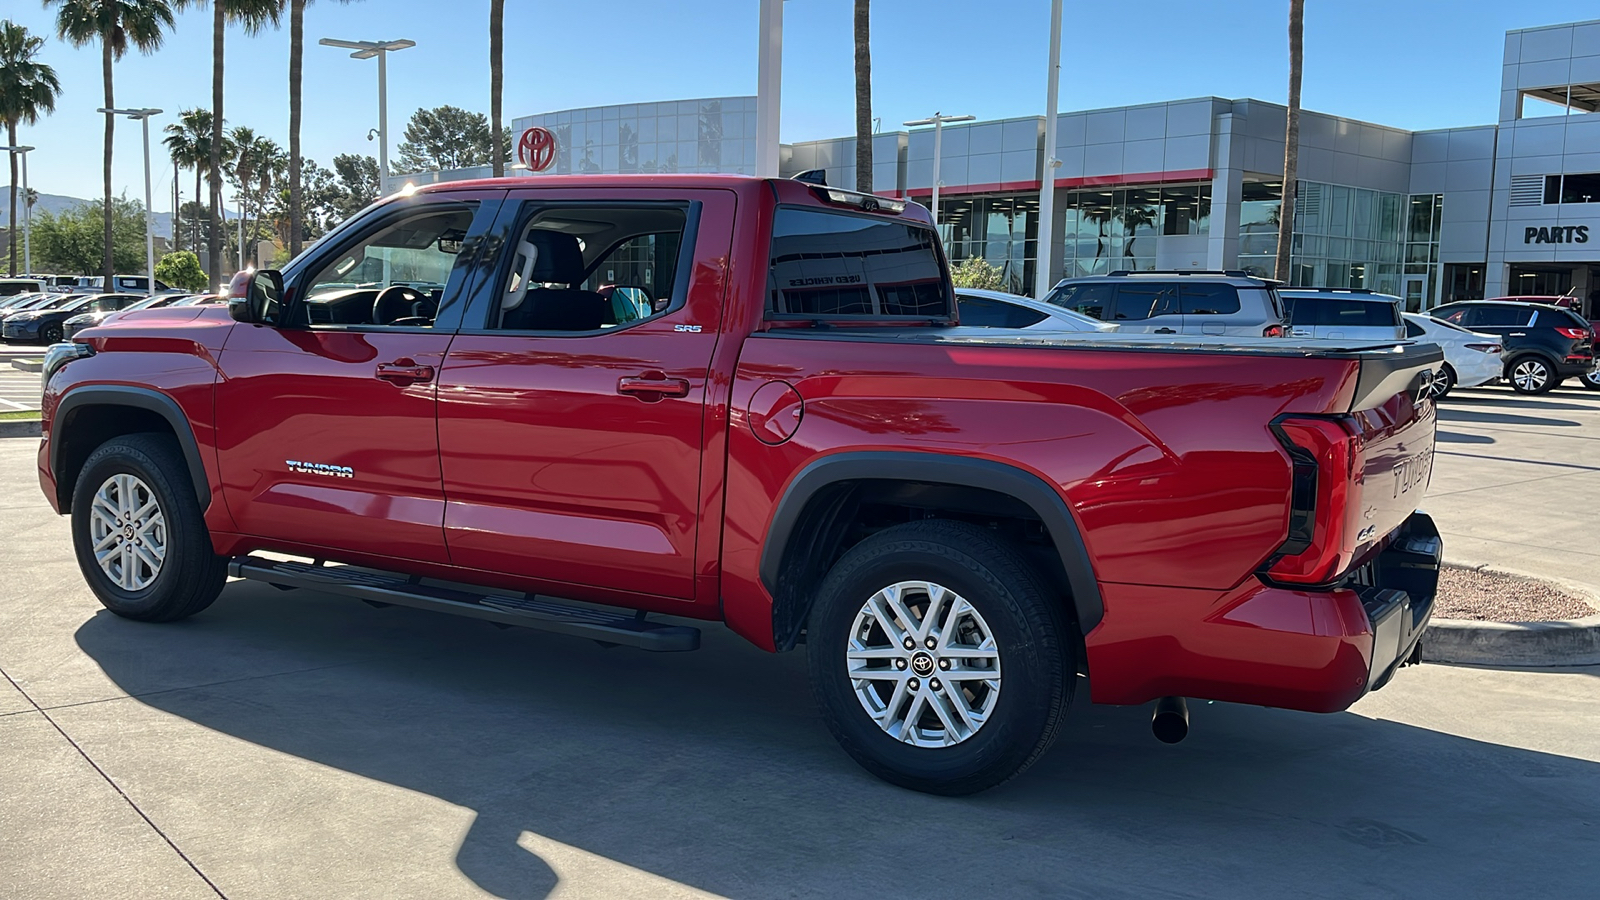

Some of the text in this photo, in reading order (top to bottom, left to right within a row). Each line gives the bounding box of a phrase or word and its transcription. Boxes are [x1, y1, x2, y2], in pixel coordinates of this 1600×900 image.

[1524, 225, 1589, 244] PARTS
[673, 324, 702, 333] SR5
[285, 460, 354, 478] TUNDRA
